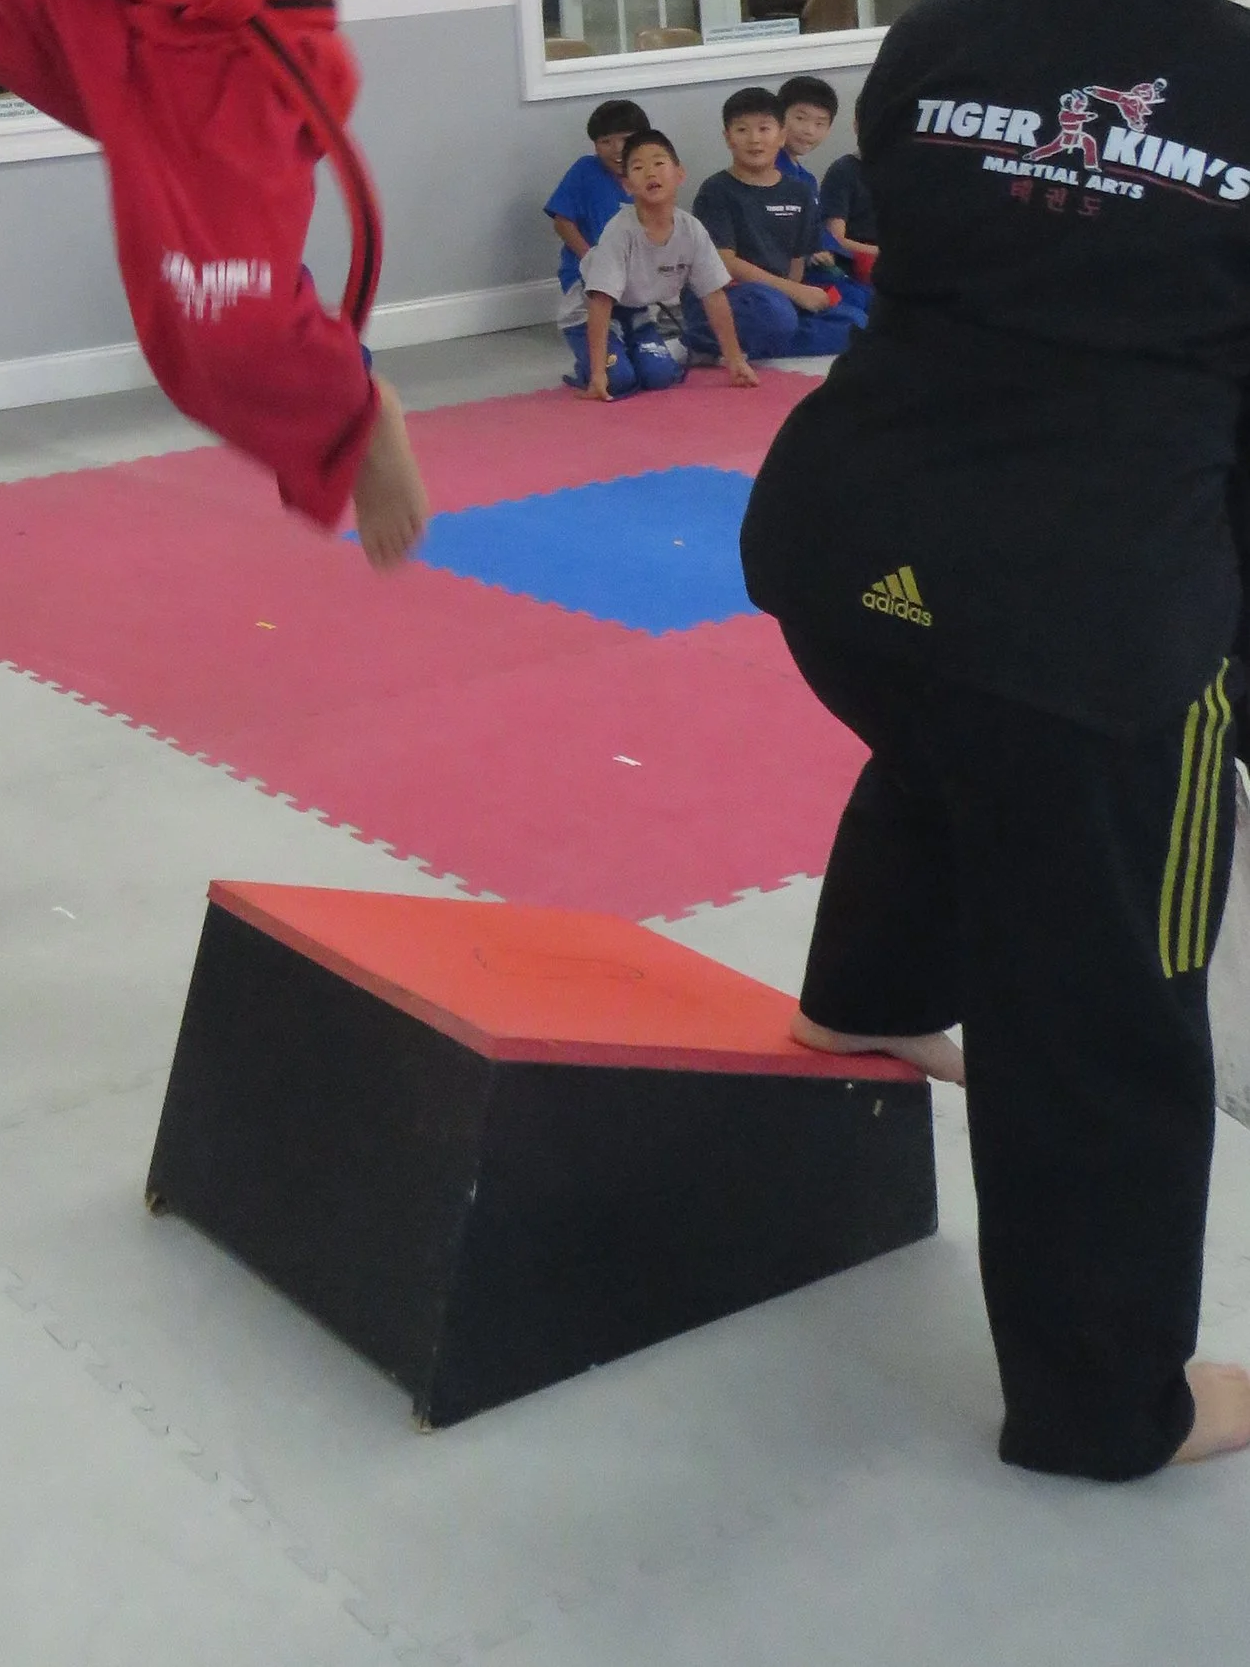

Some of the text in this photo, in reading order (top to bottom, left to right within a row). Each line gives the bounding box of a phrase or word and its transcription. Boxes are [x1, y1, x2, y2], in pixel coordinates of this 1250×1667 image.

[916, 99, 1250, 201] TIGER KIM'S
[982, 156, 1144, 200] MARTIAL ARTS
[861, 592, 933, 627] adidas
